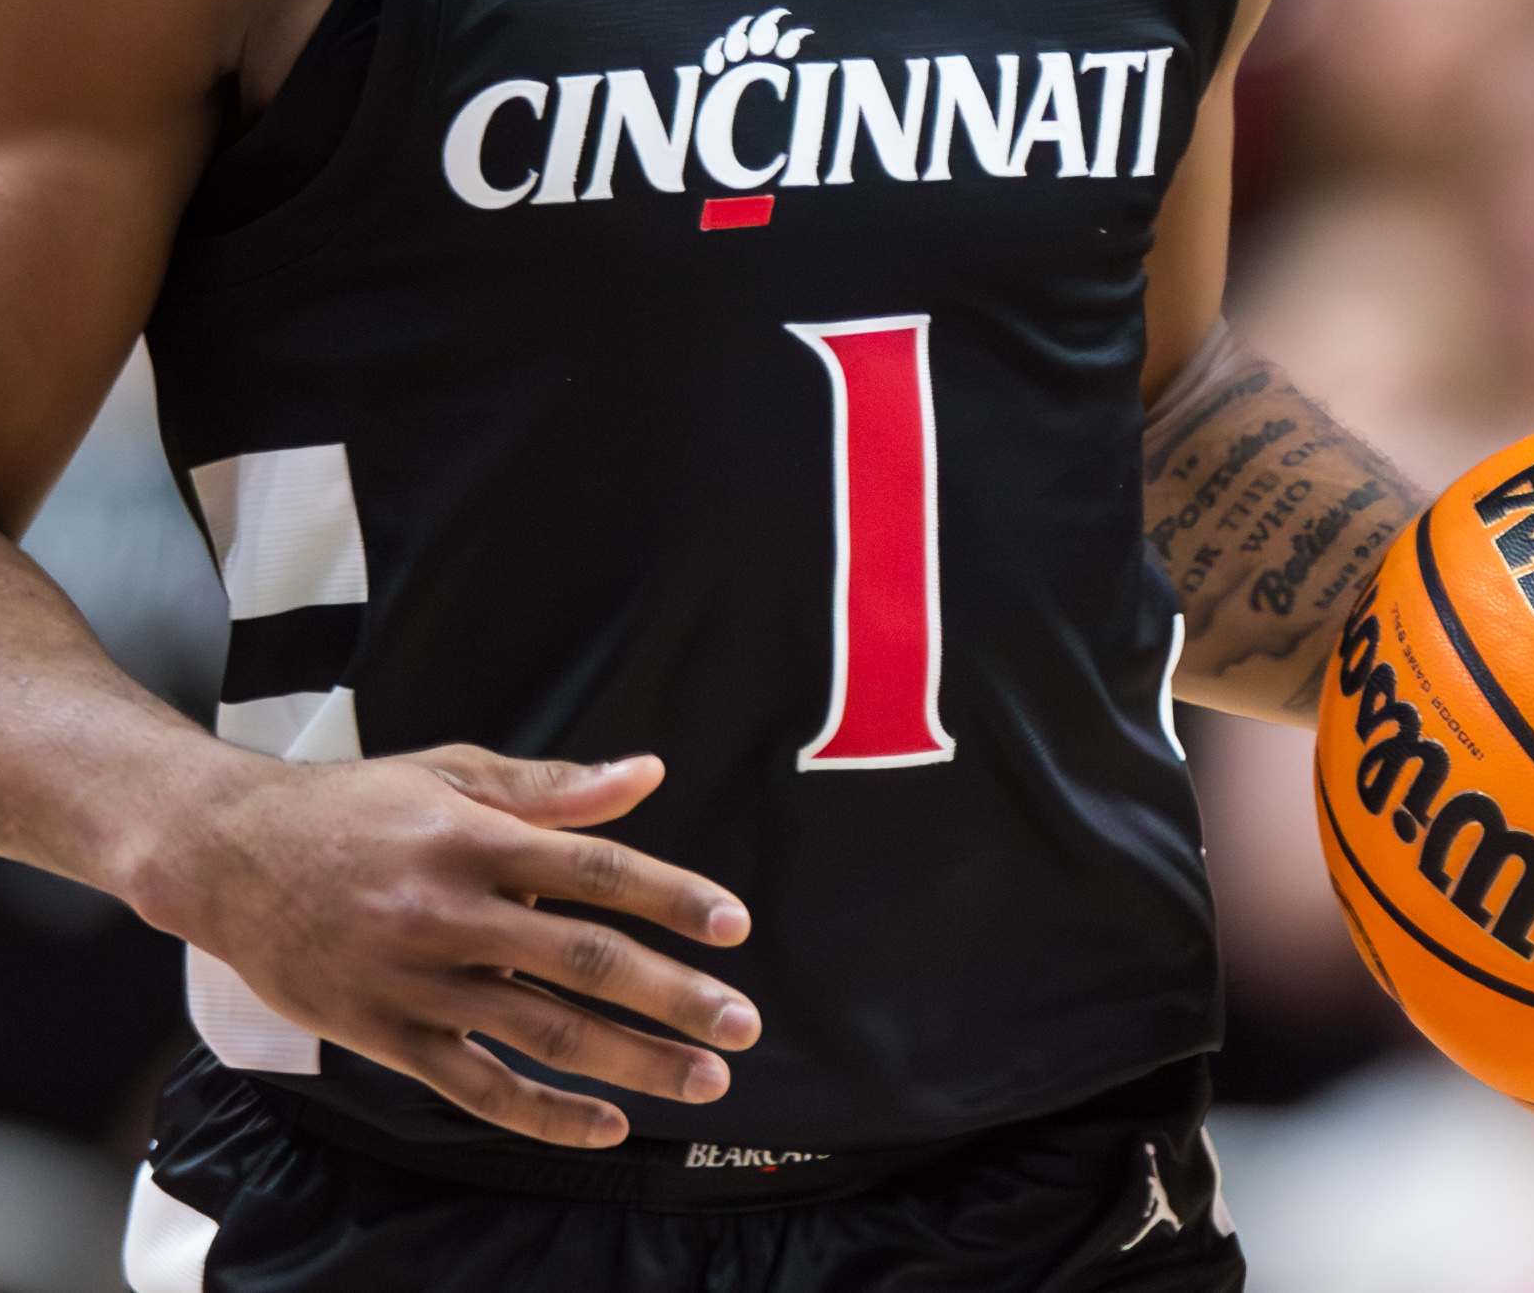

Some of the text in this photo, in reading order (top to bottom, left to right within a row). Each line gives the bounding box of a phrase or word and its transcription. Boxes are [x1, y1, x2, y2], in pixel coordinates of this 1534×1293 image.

[441, 46, 1174, 210] CINCINNATI
[783, 313, 957, 773] 1
[1240, 479, 1313, 552] WHO
[1430, 694, 1486, 762] INDOOR
[684, 1142, 831, 1168] BEARC
